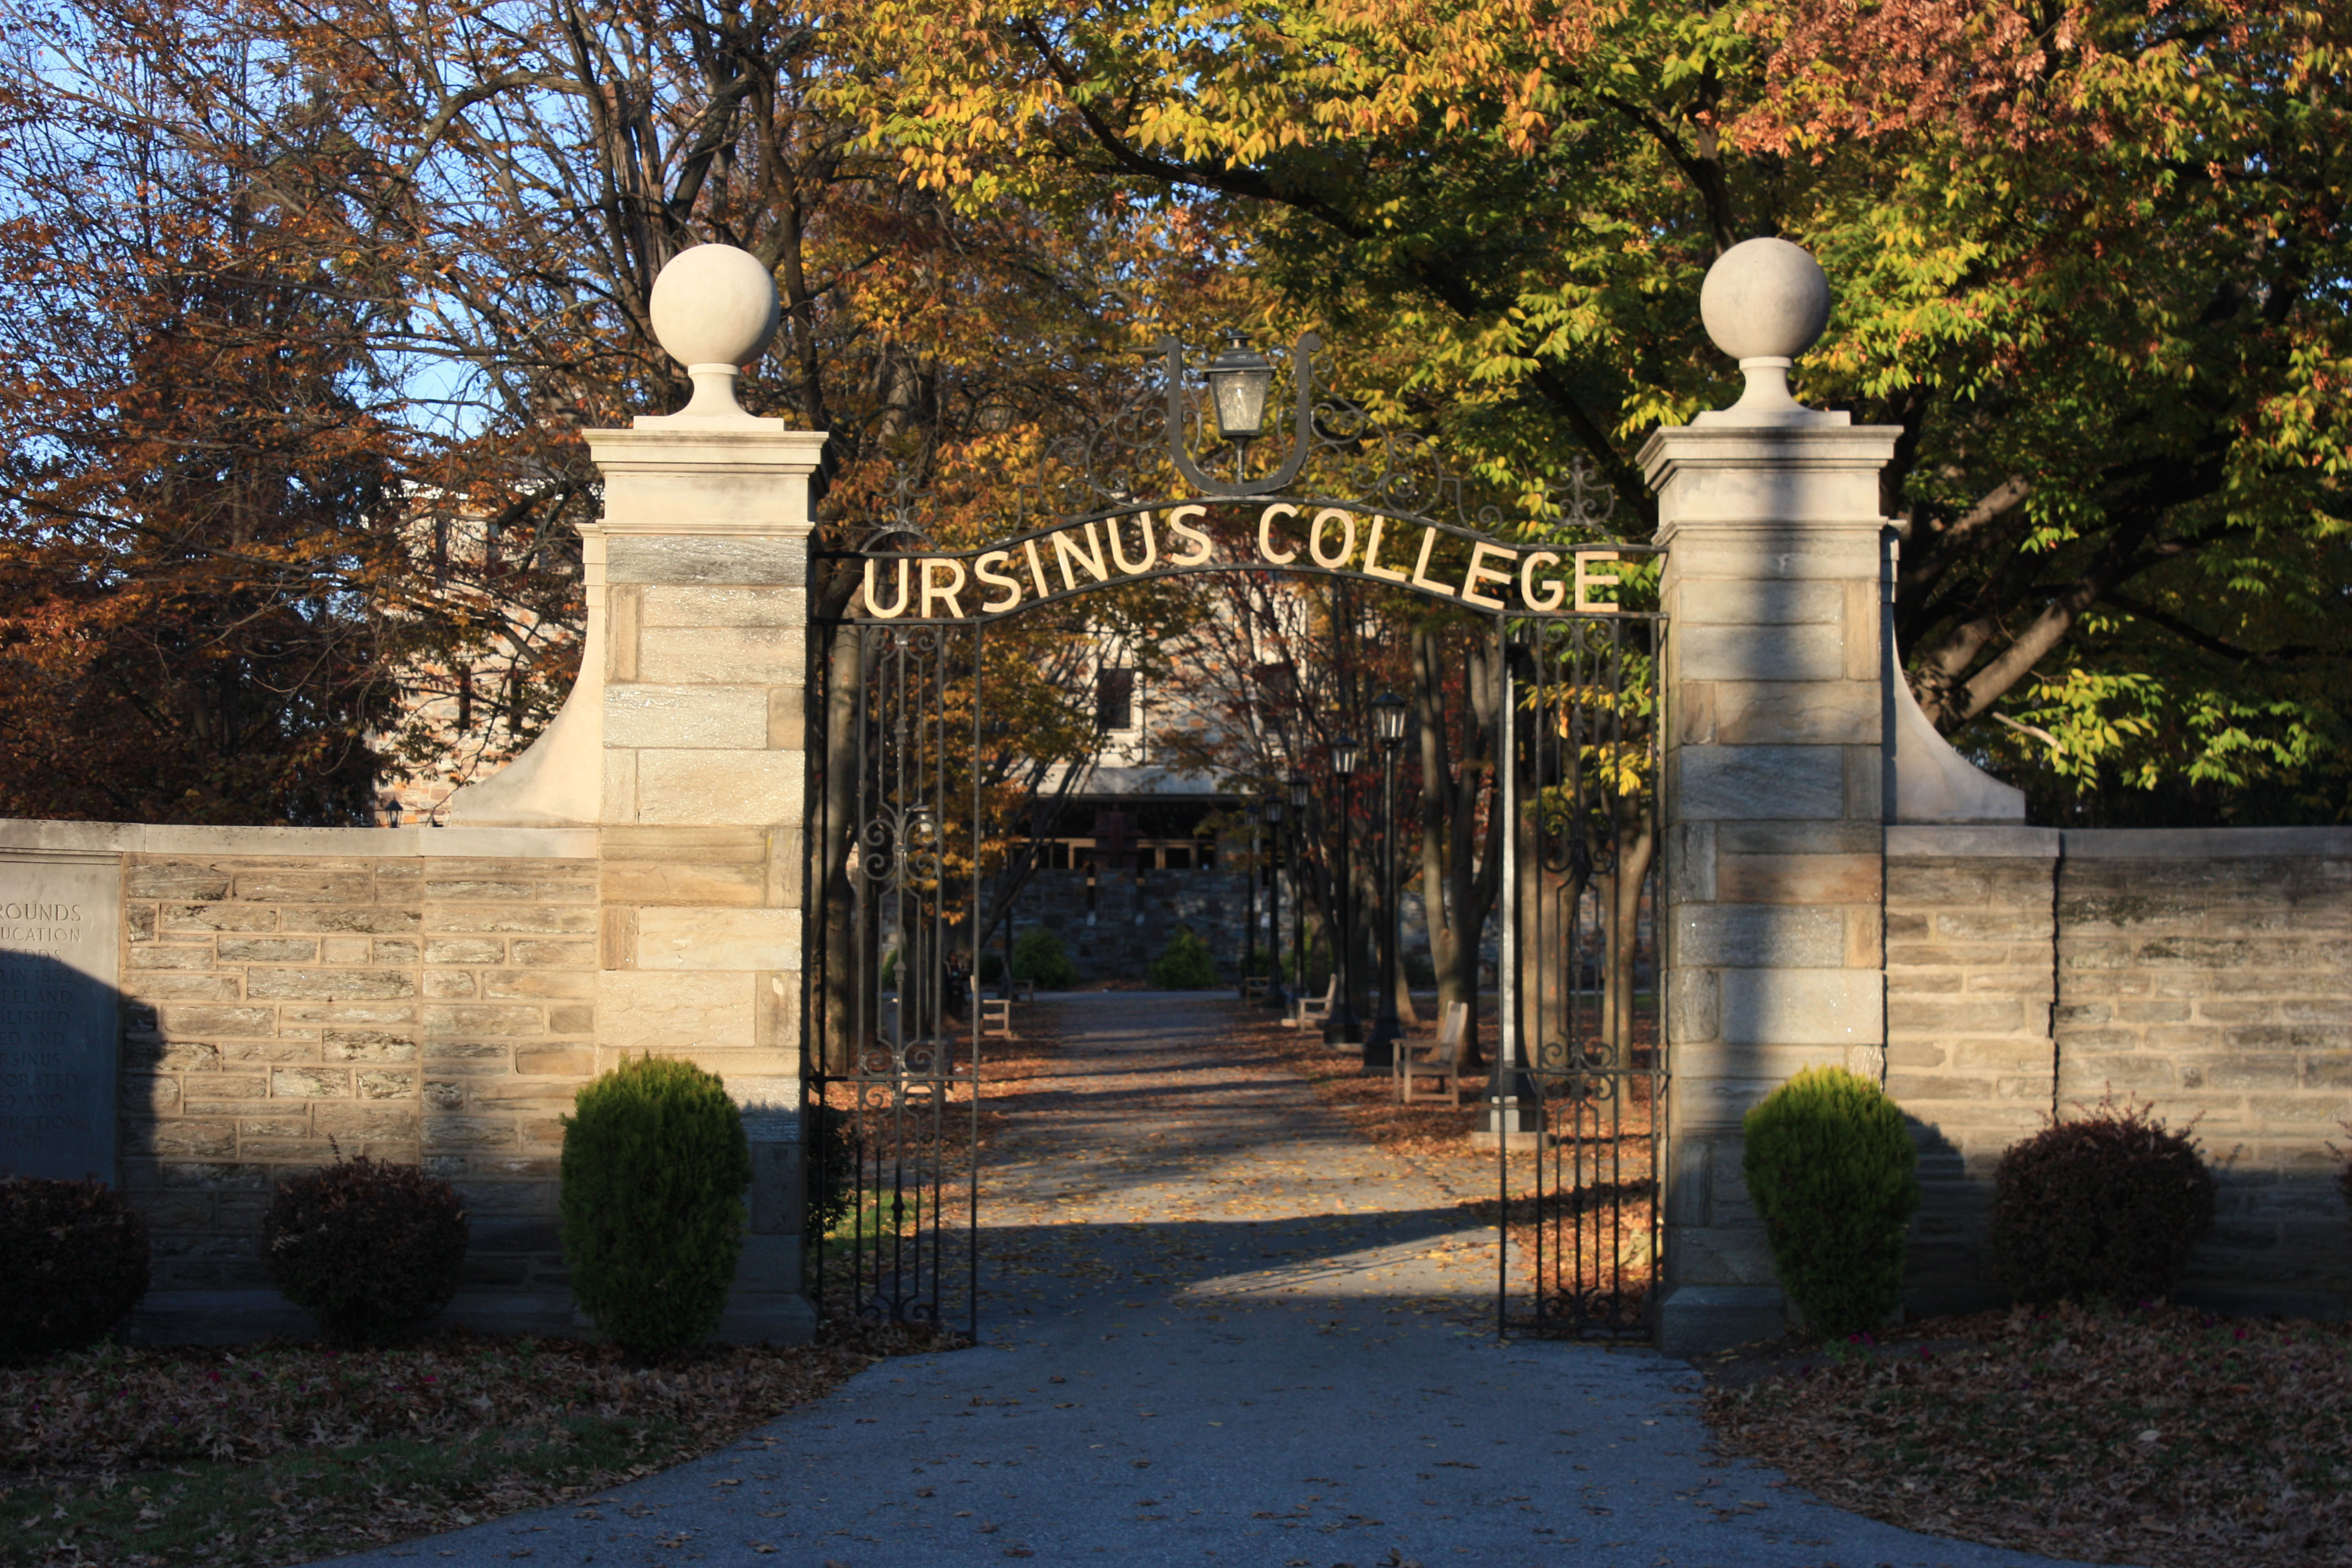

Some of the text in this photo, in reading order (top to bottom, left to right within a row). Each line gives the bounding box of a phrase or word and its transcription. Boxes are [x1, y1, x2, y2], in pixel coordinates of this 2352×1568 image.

[864, 503, 1619, 618] URSINUS COLLEGE
[1, 927, 81, 942] UCATION
[29, 1031, 66, 1046] AND
